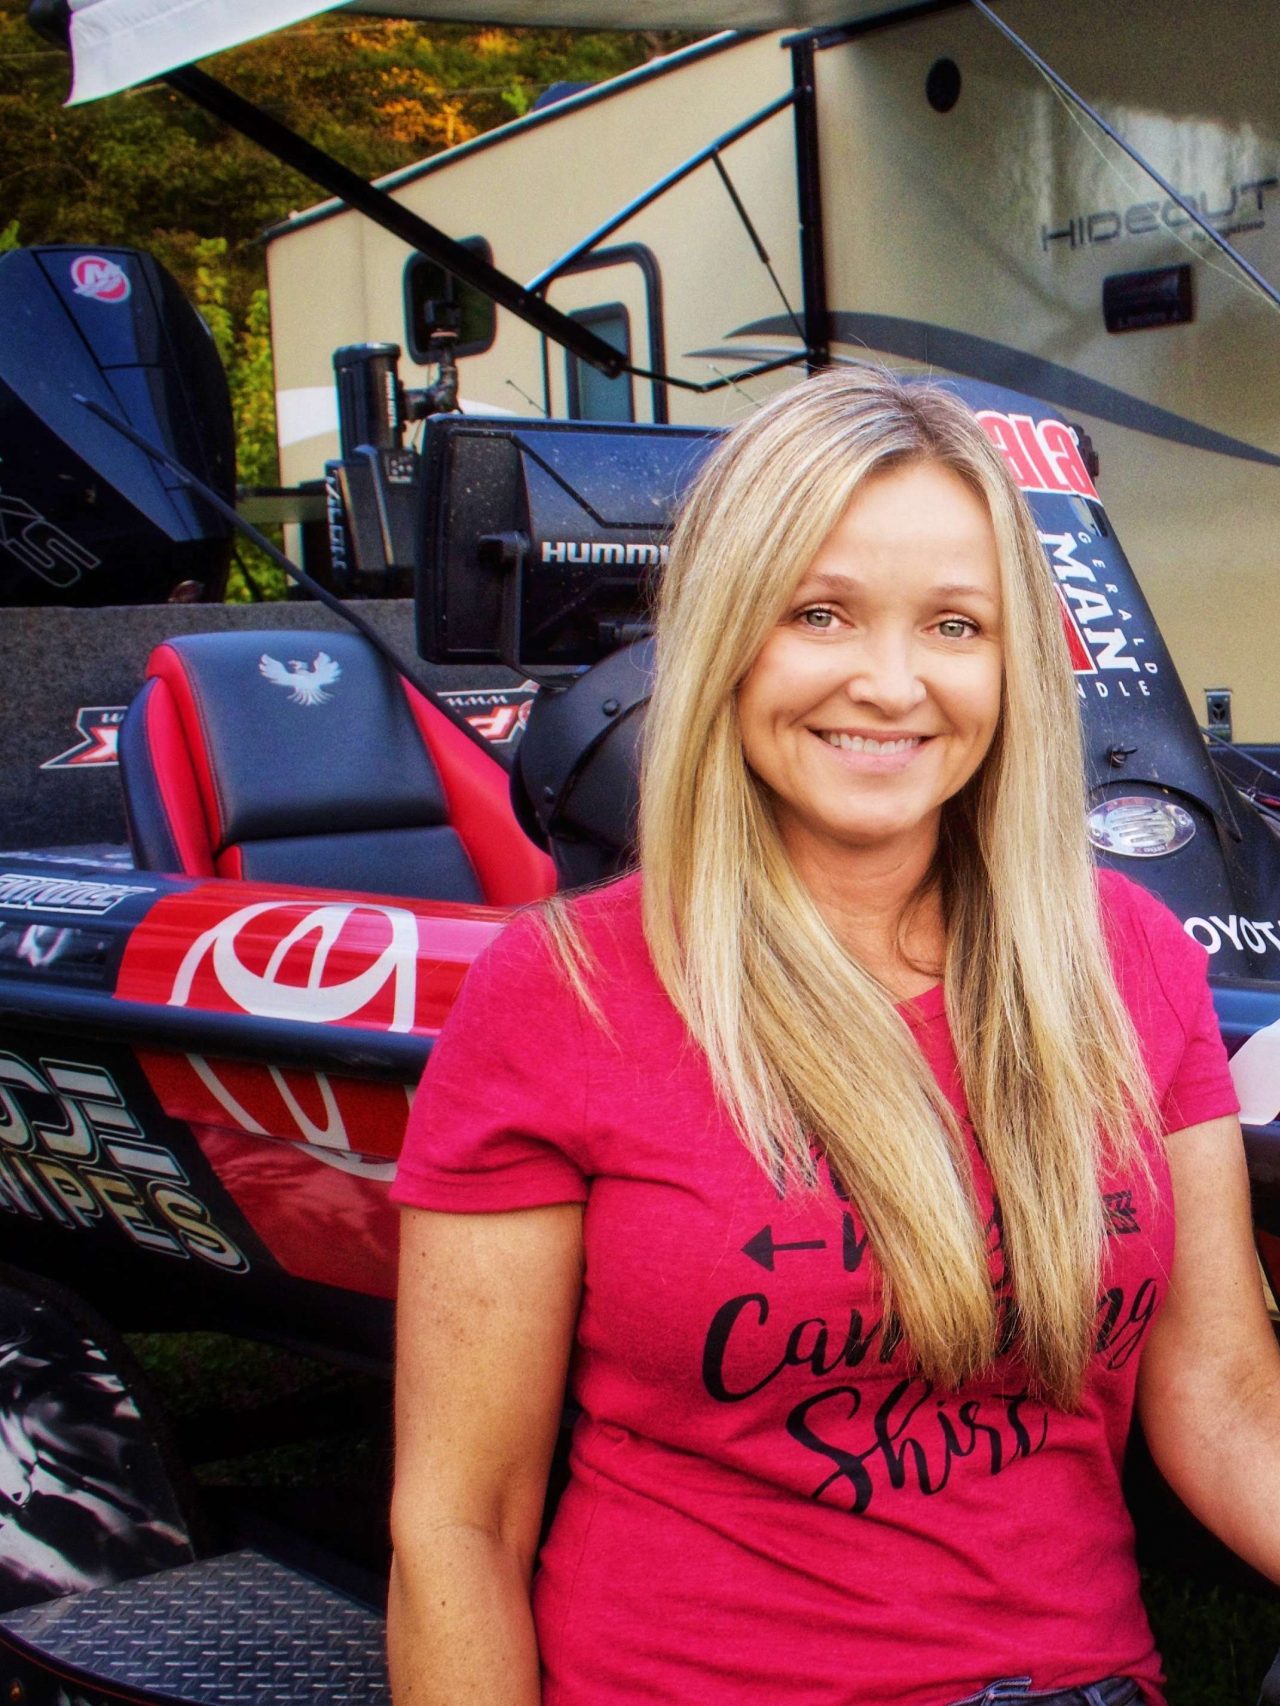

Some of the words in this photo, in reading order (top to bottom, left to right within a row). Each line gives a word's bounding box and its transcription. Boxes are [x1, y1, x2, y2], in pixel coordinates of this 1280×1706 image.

[1041, 177, 1279, 251] HIDEOUT
[1036, 529, 1141, 673] MAN
[1077, 531, 1159, 674] GERALD
[785, 1376, 1049, 1514] Shirt
